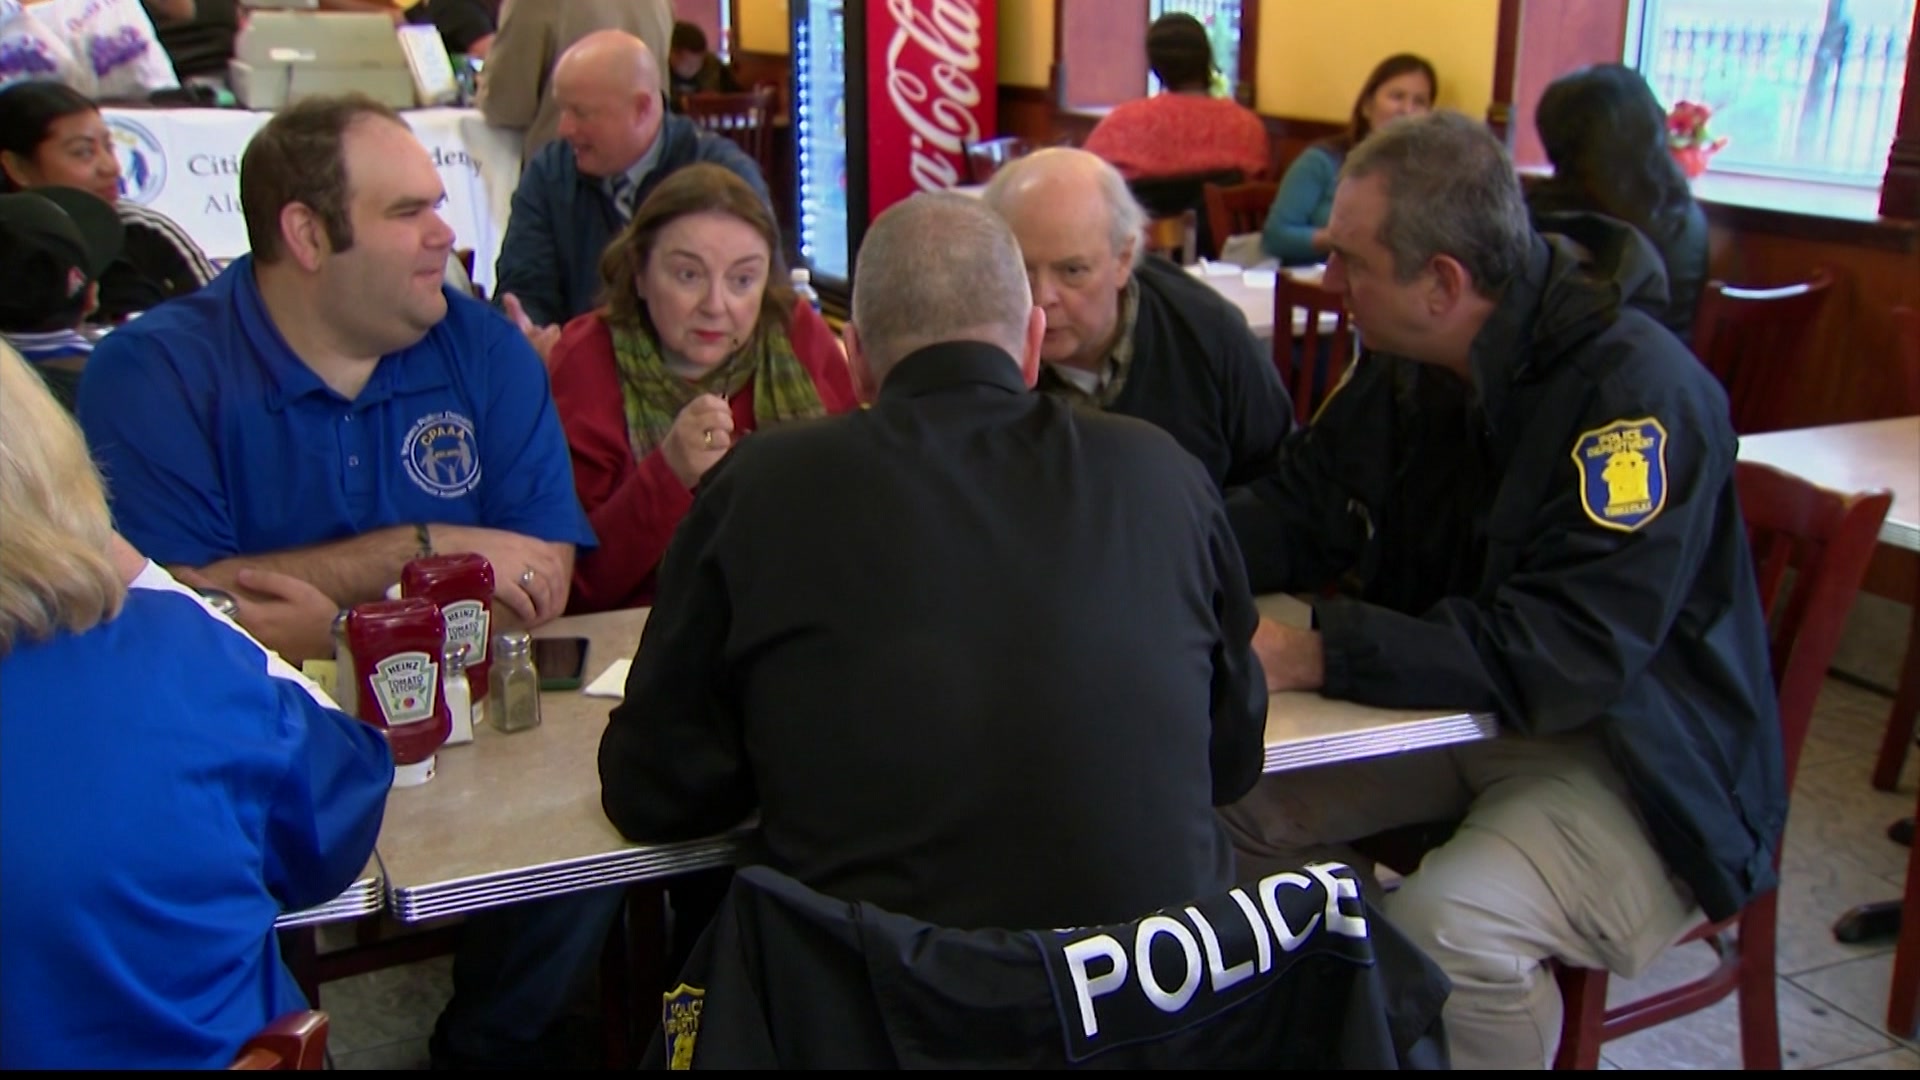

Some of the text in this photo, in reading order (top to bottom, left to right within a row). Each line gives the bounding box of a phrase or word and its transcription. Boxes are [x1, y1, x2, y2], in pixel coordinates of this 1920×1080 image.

[187, 153, 240, 177] Citi
[1598, 428, 1642, 447] POLICE
[448, 609, 475, 622] HEINZ
[388, 661, 419, 674] HEINZ
[388, 675, 424, 688] TOMATO
[1064, 861, 1368, 1038] POLICE
